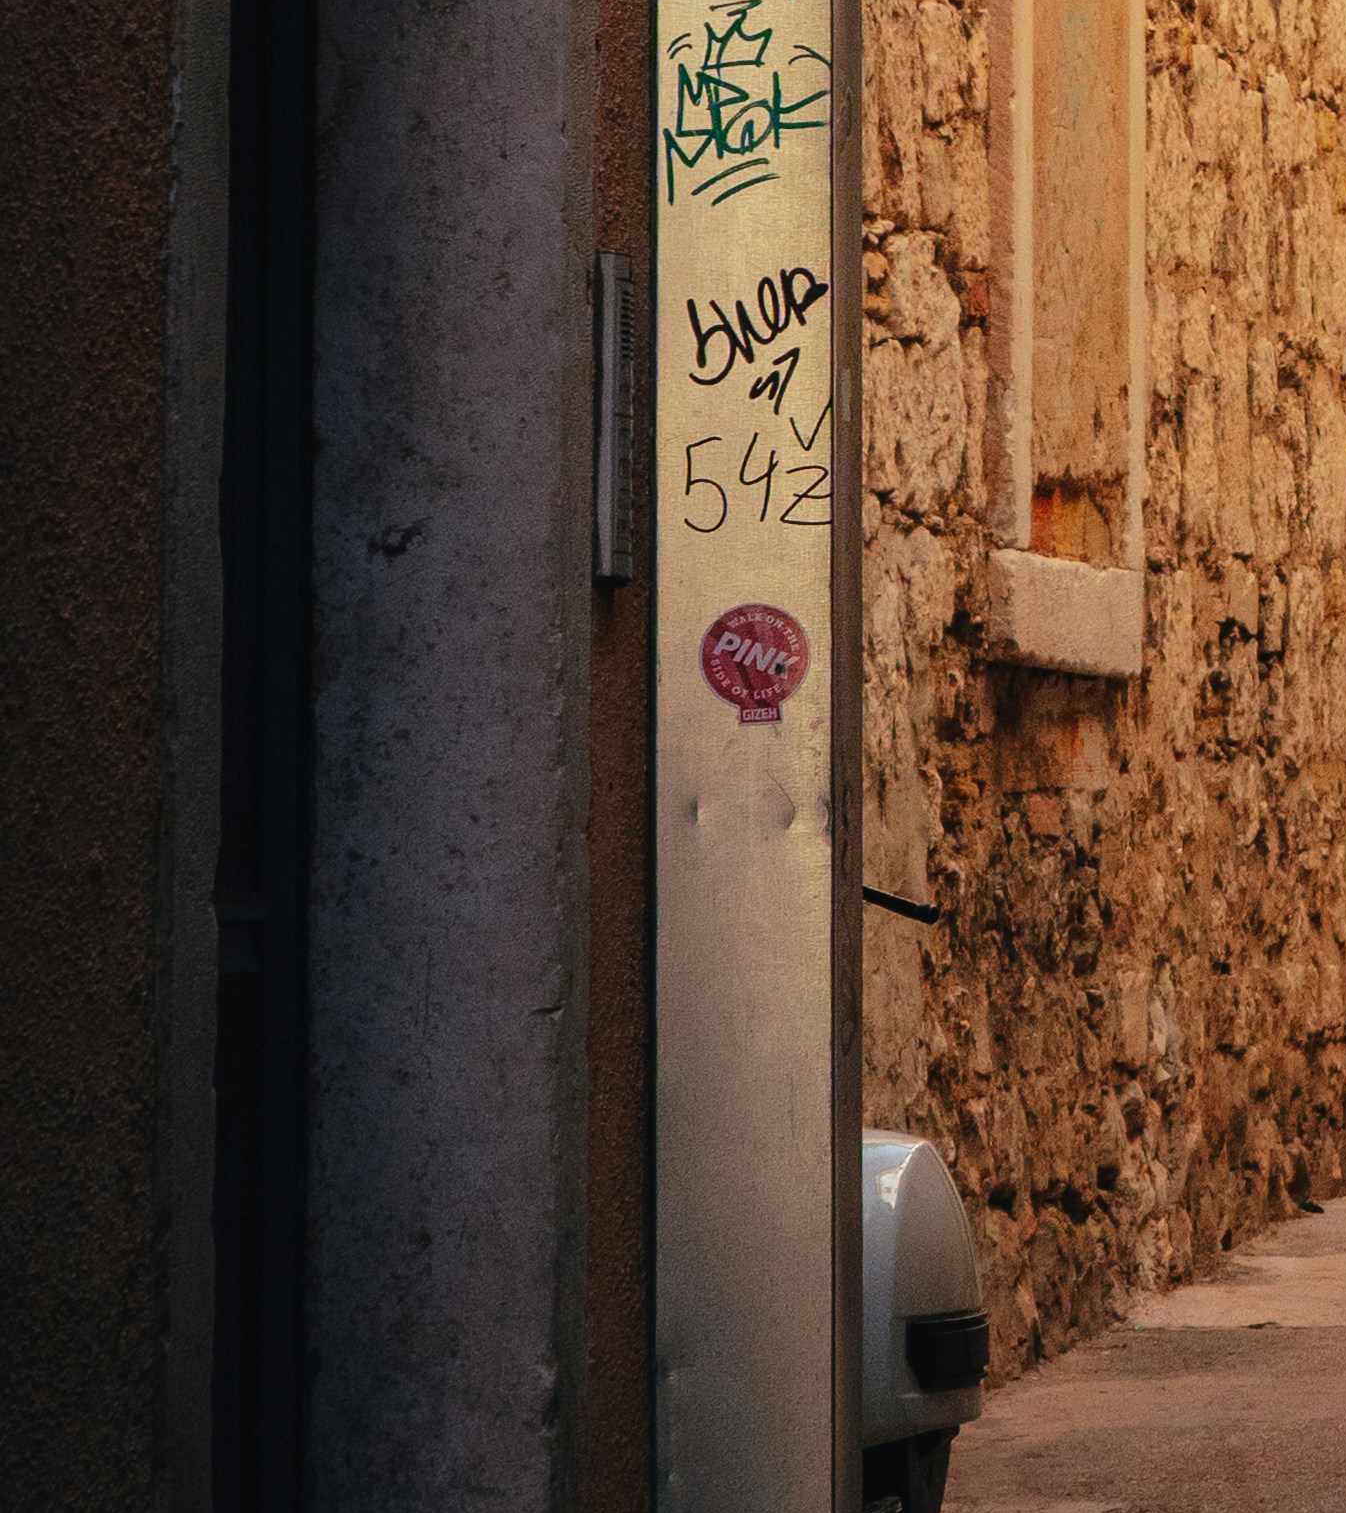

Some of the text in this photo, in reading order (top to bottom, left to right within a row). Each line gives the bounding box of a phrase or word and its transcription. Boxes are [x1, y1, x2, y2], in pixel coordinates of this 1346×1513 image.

[726, 612, 800, 652] WALK ON THE
[712, 630, 801, 680] PINK
[710, 658, 783, 700] SIDE OF LIFE
[742, 708, 778, 721] GIZEH
